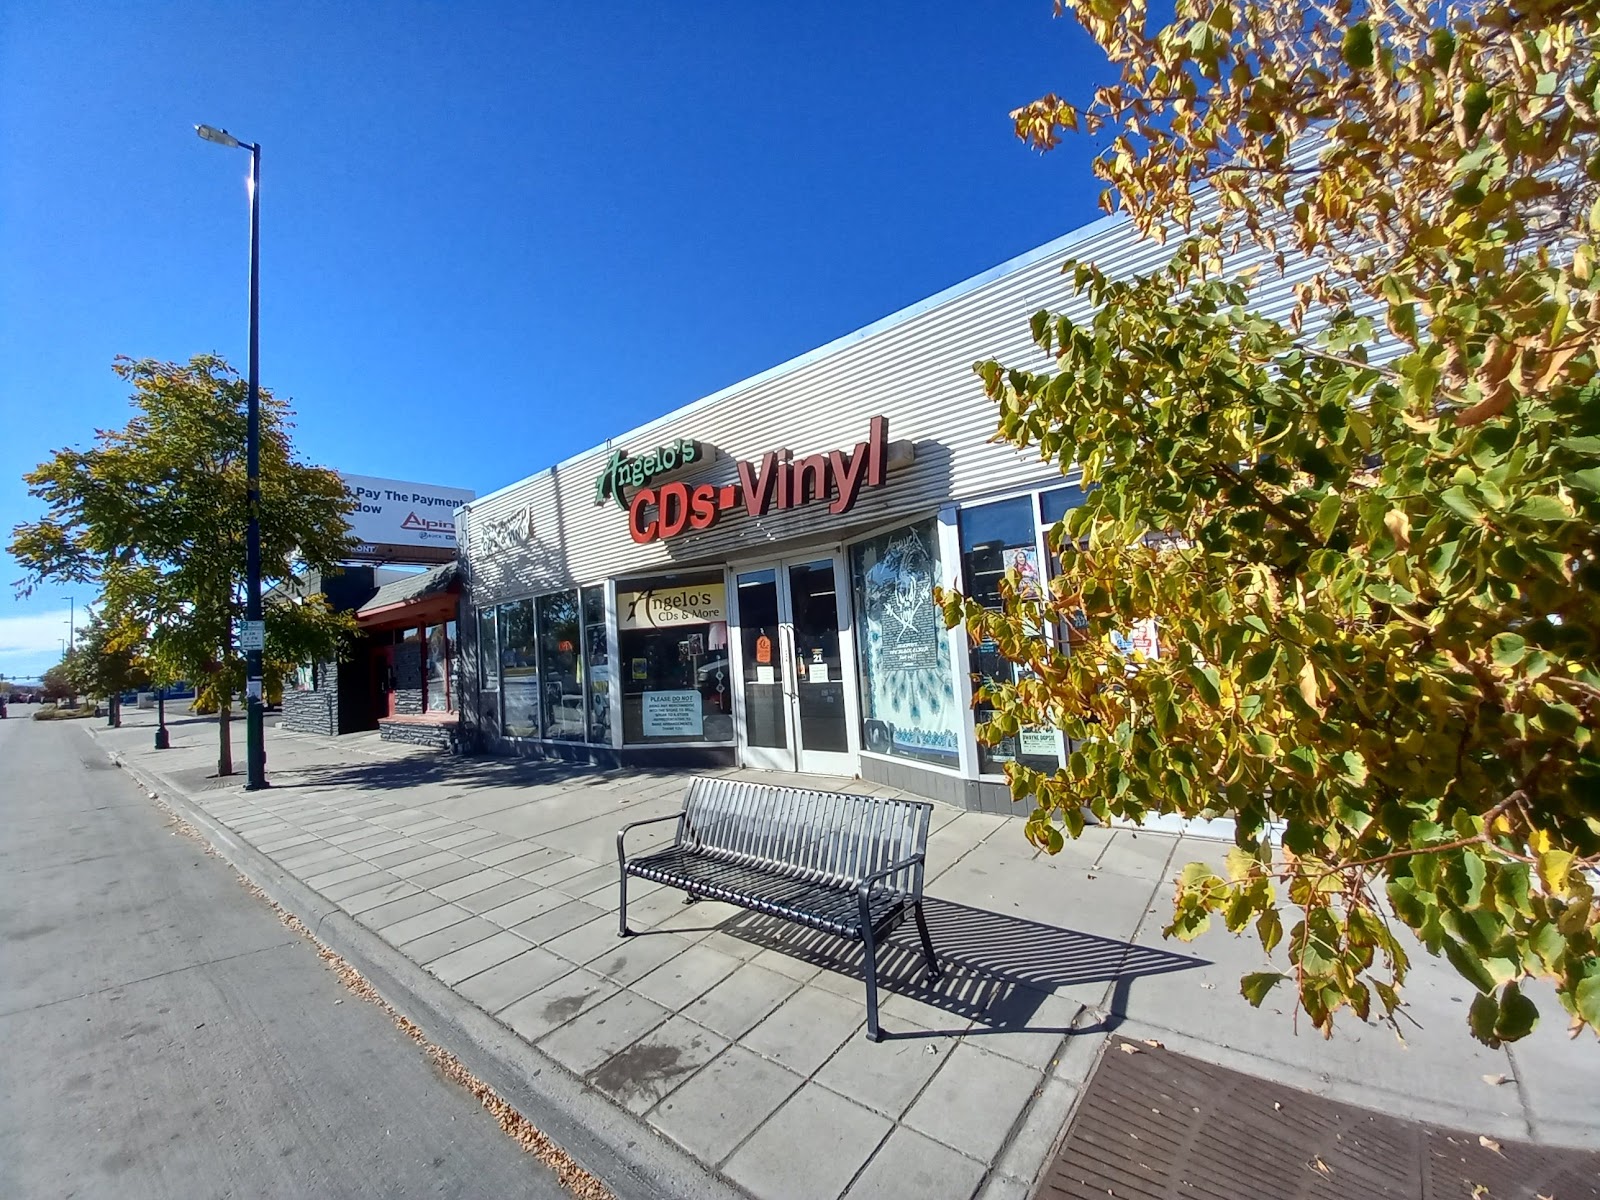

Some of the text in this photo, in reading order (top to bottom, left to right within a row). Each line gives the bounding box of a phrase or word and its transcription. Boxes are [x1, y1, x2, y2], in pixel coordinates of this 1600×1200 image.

[356, 487, 381, 501] Pay
[385, 490, 409, 502] The
[594, 438, 696, 511] Angelo's
[629, 415, 887, 544] CDs Vinyl
[626, 588, 711, 628] Angelo's
[658, 608, 720, 622] CDs & More
